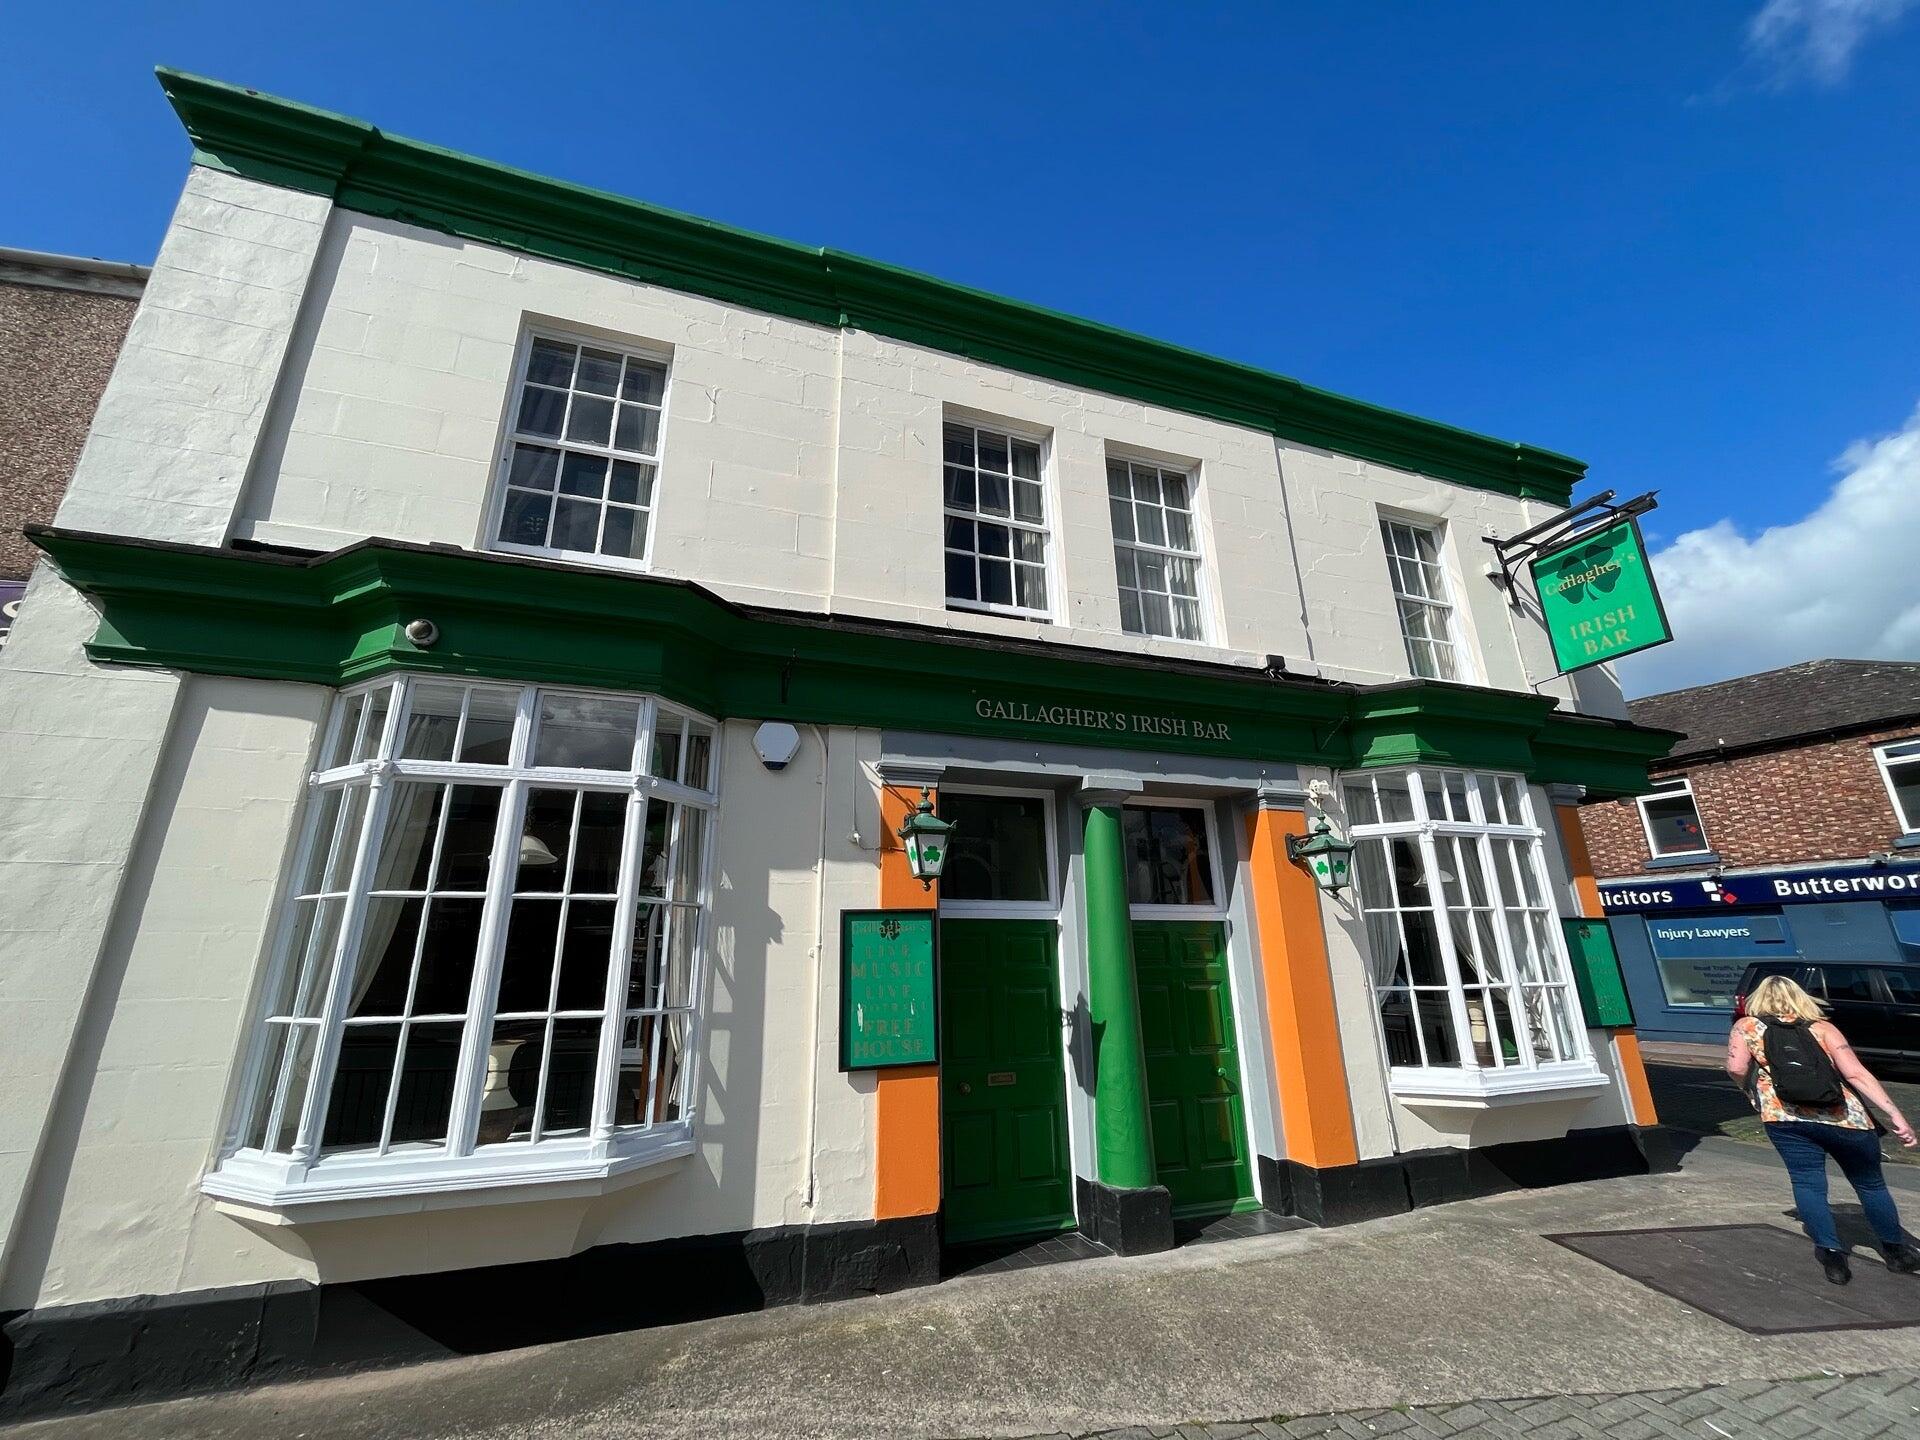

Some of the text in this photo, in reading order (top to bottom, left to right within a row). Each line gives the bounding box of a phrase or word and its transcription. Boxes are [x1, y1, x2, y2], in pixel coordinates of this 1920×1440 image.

[1544, 552, 1637, 596] Gallagher's
[1569, 604, 1636, 640] IRISH
[1583, 628, 1632, 656] BAR
[975, 699, 1232, 741] GALLAGHER'S IRISH BAR
[1773, 873, 1920, 897] Butterwor
[1598, 889, 1673, 906] licitors
[1657, 927, 1750, 941] Injury Lawyers
[851, 960, 927, 979] MUSIC
[862, 1018, 915, 1037] FREE
[853, 1038, 925, 1058] HOUSE
